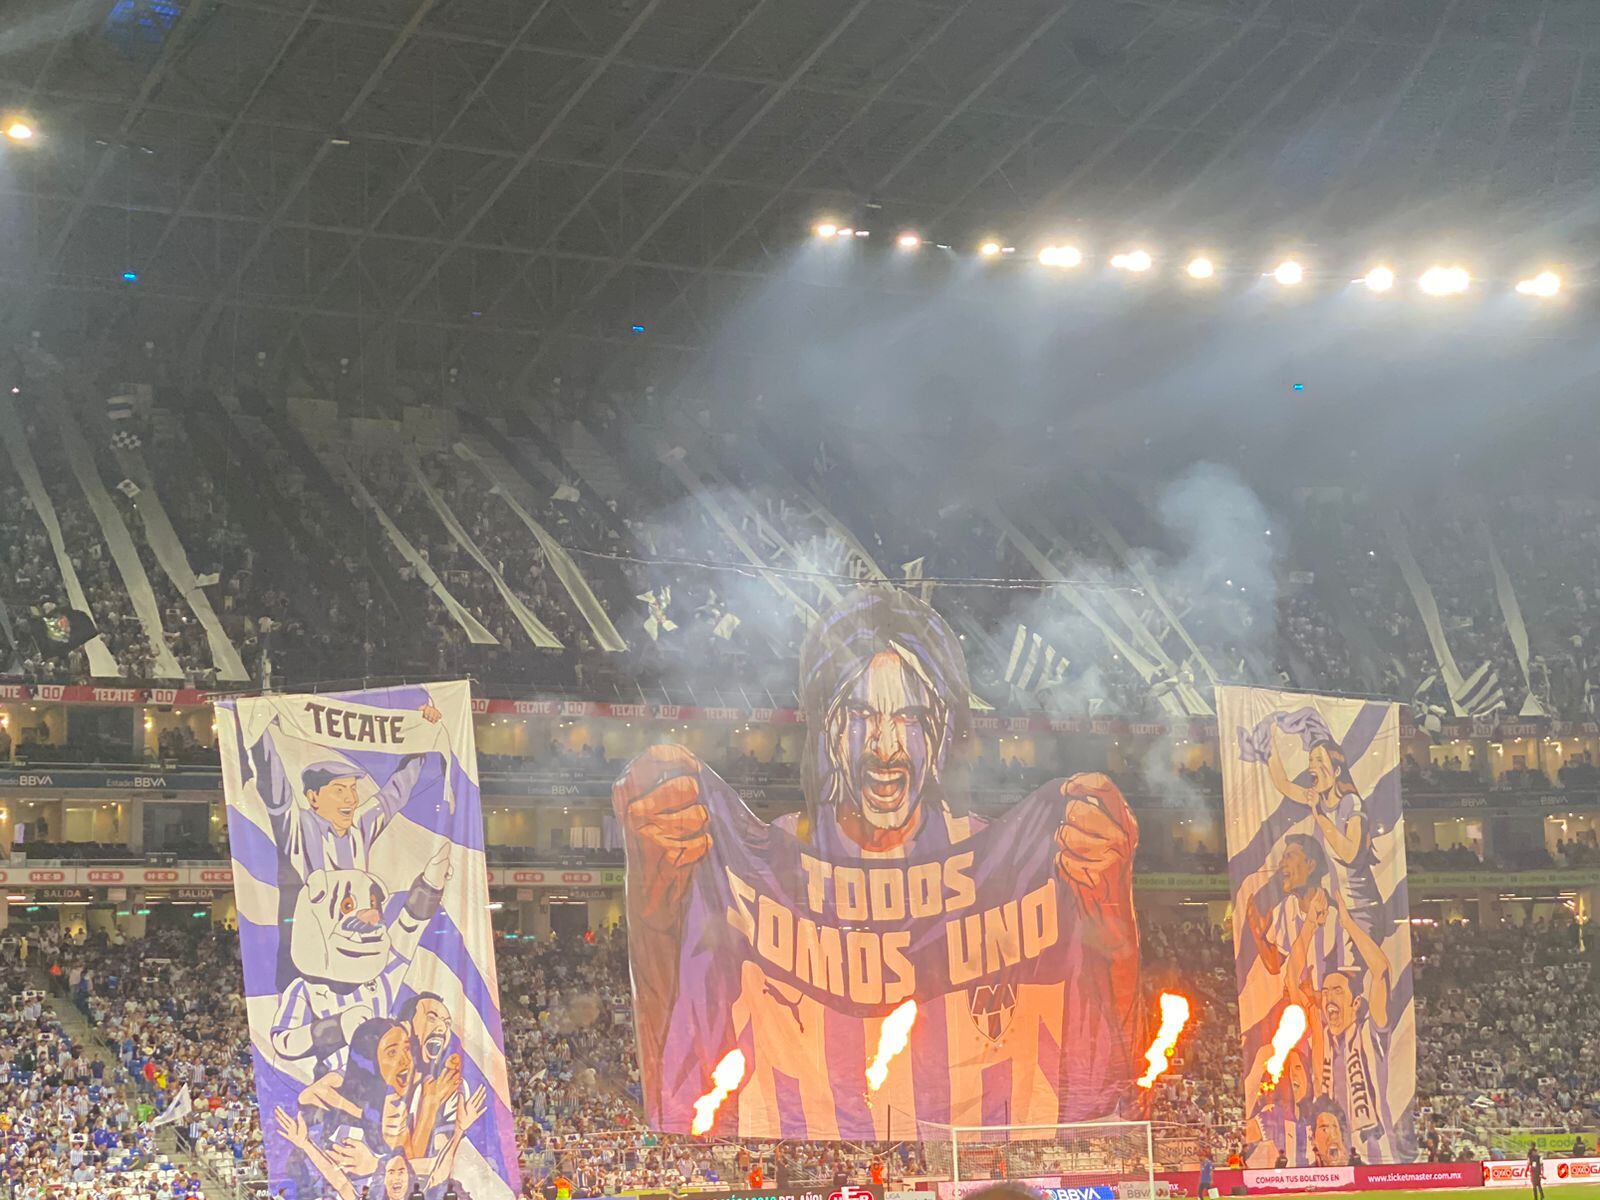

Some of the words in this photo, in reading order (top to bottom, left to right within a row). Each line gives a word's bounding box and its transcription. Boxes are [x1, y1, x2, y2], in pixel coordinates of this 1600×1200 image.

[93, 688, 136, 702] TECATE
[514, 702, 551, 715] TECATE
[610, 704, 646, 717] TECATE
[704, 707, 739, 720] TECATE
[304, 702, 405, 744] TECATE
[20, 775, 53, 787] BBVA
[134, 777, 167, 788] BBVA
[552, 784, 580, 795] BBVA
[802, 851, 975, 922] TODOS
[726, 865, 917, 1005] SOMOS
[946, 879, 1060, 986] UNO
[1347, 1048, 1371, 1120] TECATE
[1255, 1176, 1285, 1184] COMPRA
[1286, 1175, 1298, 1183] TUS
[1300, 1174, 1329, 1182] BOLETOS
[1367, 1172, 1462, 1183] www.ticketmaster.com.mx
[1058, 1187, 1102, 1200] BBVA
